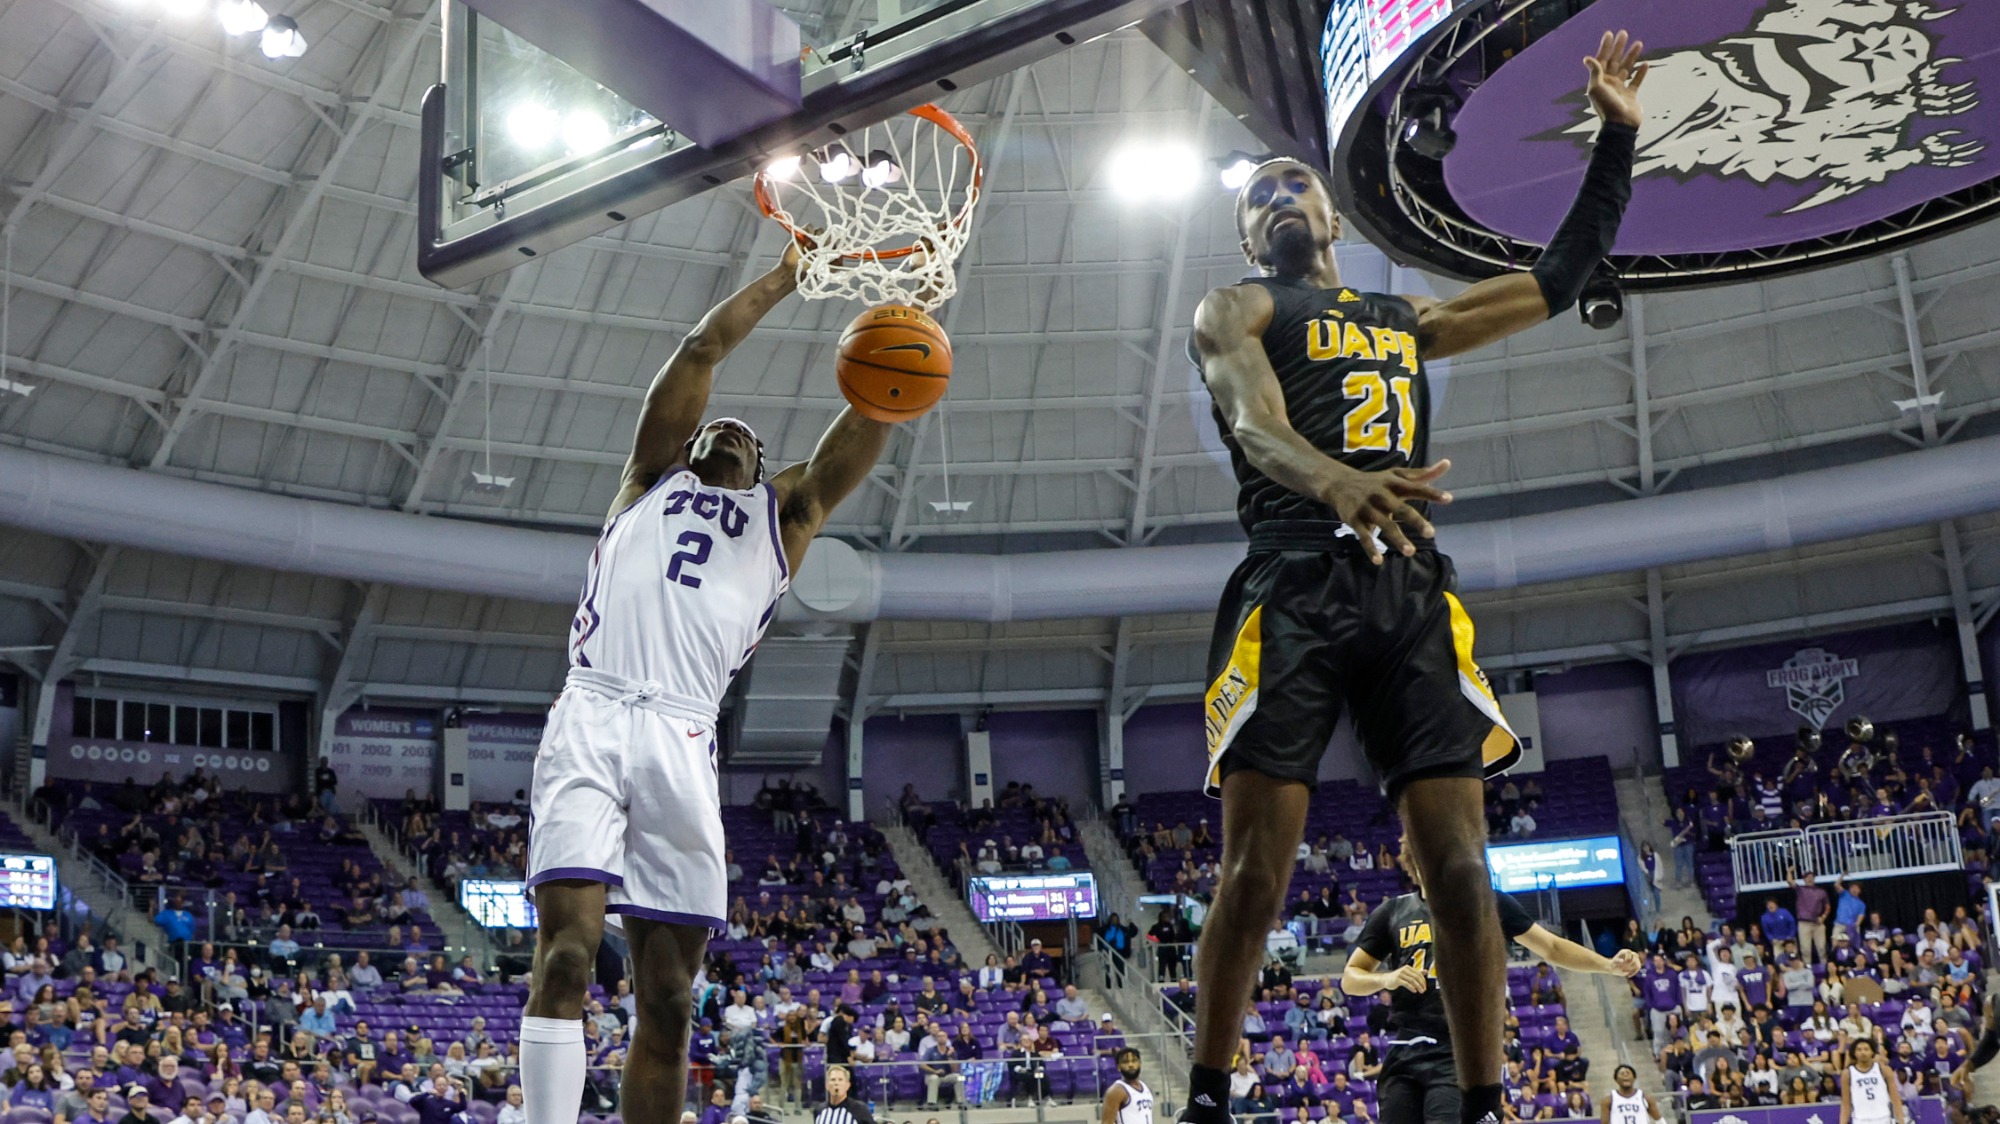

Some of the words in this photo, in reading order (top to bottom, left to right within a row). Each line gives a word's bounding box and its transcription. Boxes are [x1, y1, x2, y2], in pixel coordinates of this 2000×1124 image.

[873, 308, 935, 330] ELITE
[1342, 370, 1416, 461] 21
[663, 489, 750, 538] TCU
[665, 530, 714, 589] 2
[1769, 667, 1809, 685] FROG
[1811, 660, 1856, 681] ARMY
[1205, 666, 1249, 762] OLDEN
[351, 719, 411, 735] WOMEN'S
[361, 744, 392, 757] 2002
[401, 745, 432, 758] 2003
[467, 748, 495, 760] 2004
[504, 750, 535, 762] 2005
[1399, 923, 1432, 948] UA
[1856, 1076, 1878, 1087] TCU
[1866, 1088, 1875, 1100] 5
[1617, 1104, 1640, 1113] TCU
